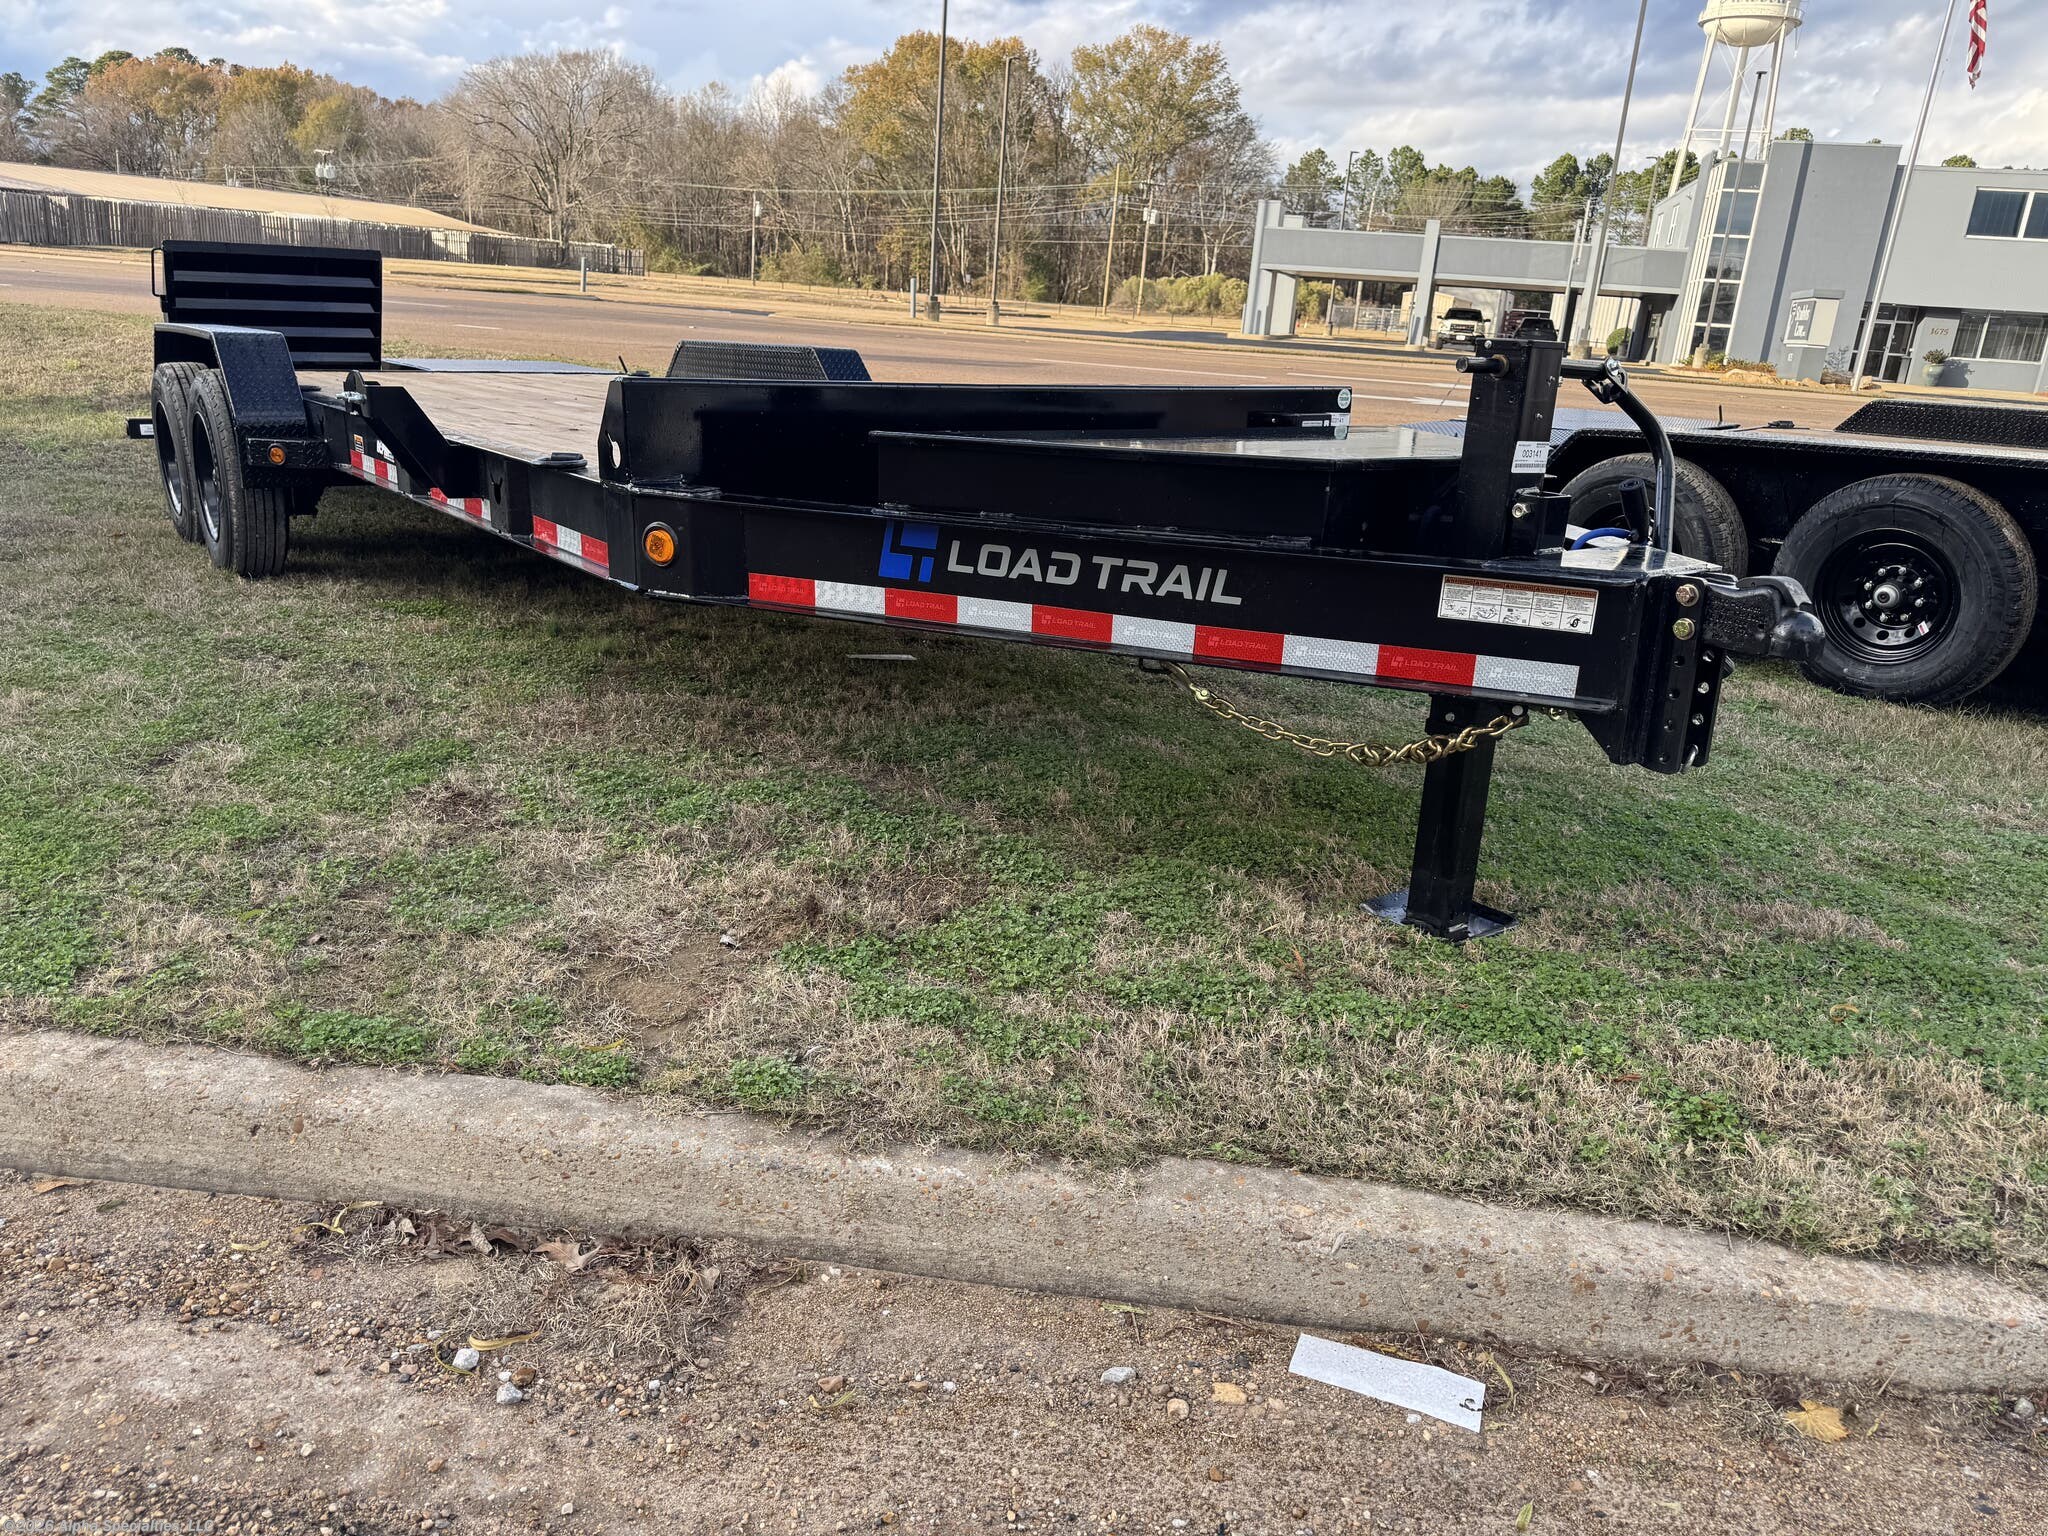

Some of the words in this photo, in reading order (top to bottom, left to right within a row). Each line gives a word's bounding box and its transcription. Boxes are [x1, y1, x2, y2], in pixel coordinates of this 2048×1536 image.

[947, 539, 1082, 586] LOAD
[1091, 555, 1243, 605] TRAIL
[1052, 617, 1073, 625] LOAD
[1074, 620, 1096, 629] TRAIL
[1219, 639, 1244, 648] LOAD
[1245, 641, 1268, 650] TRAIL
